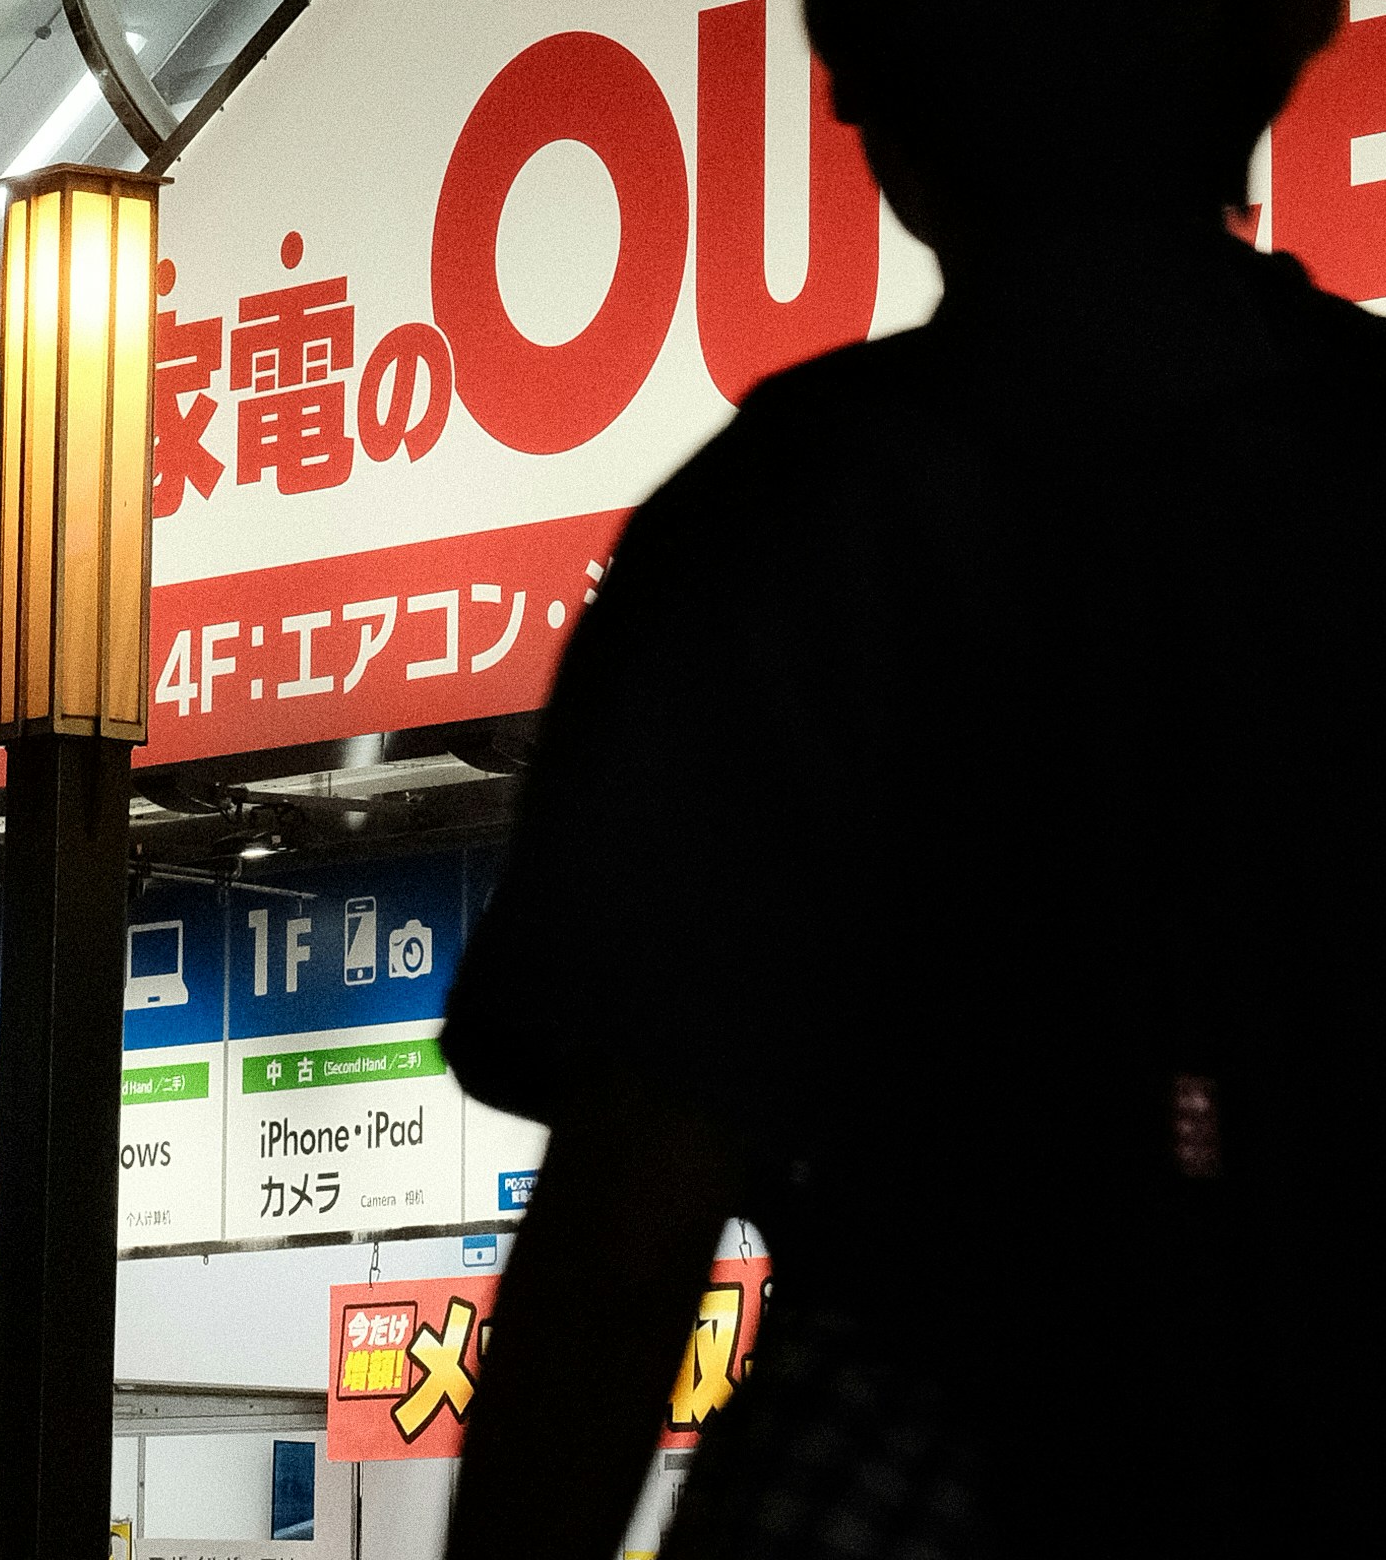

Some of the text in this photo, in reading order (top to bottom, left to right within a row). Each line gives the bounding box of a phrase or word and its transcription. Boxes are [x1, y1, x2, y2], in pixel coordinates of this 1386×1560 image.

[247, 909, 313, 997] 1F
[265, 1058, 314, 1087] 中古
[361, 1056, 387, 1073] Hand
[260, 1171, 341, 1219] カメラ
[360, 1191, 397, 1209] Camera
[348, 1308, 409, 1347] 今だけ
[342, 1348, 408, 1393] 増額!
